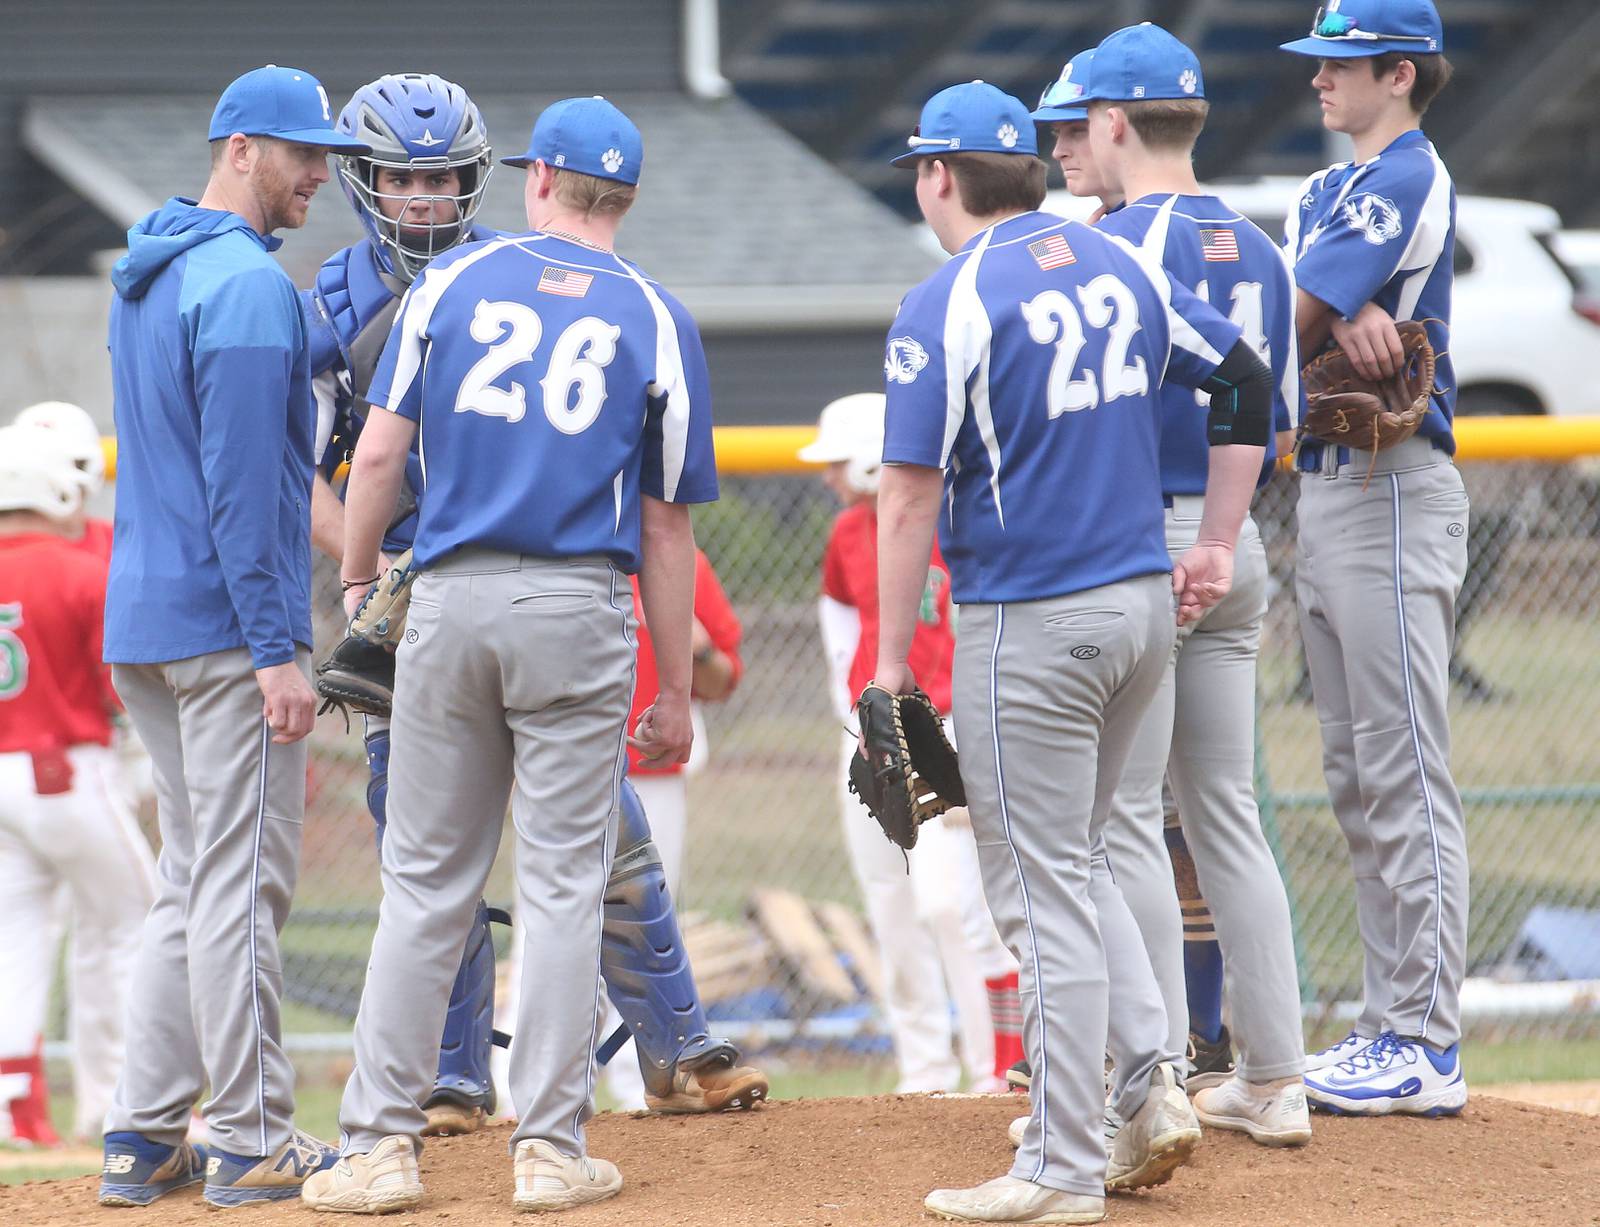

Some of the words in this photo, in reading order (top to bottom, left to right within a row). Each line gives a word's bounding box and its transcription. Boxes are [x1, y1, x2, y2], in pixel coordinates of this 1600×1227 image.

[453, 299, 622, 435] 26
[1020, 273, 1148, 420] 22
[103, 1153, 136, 1174] NB
